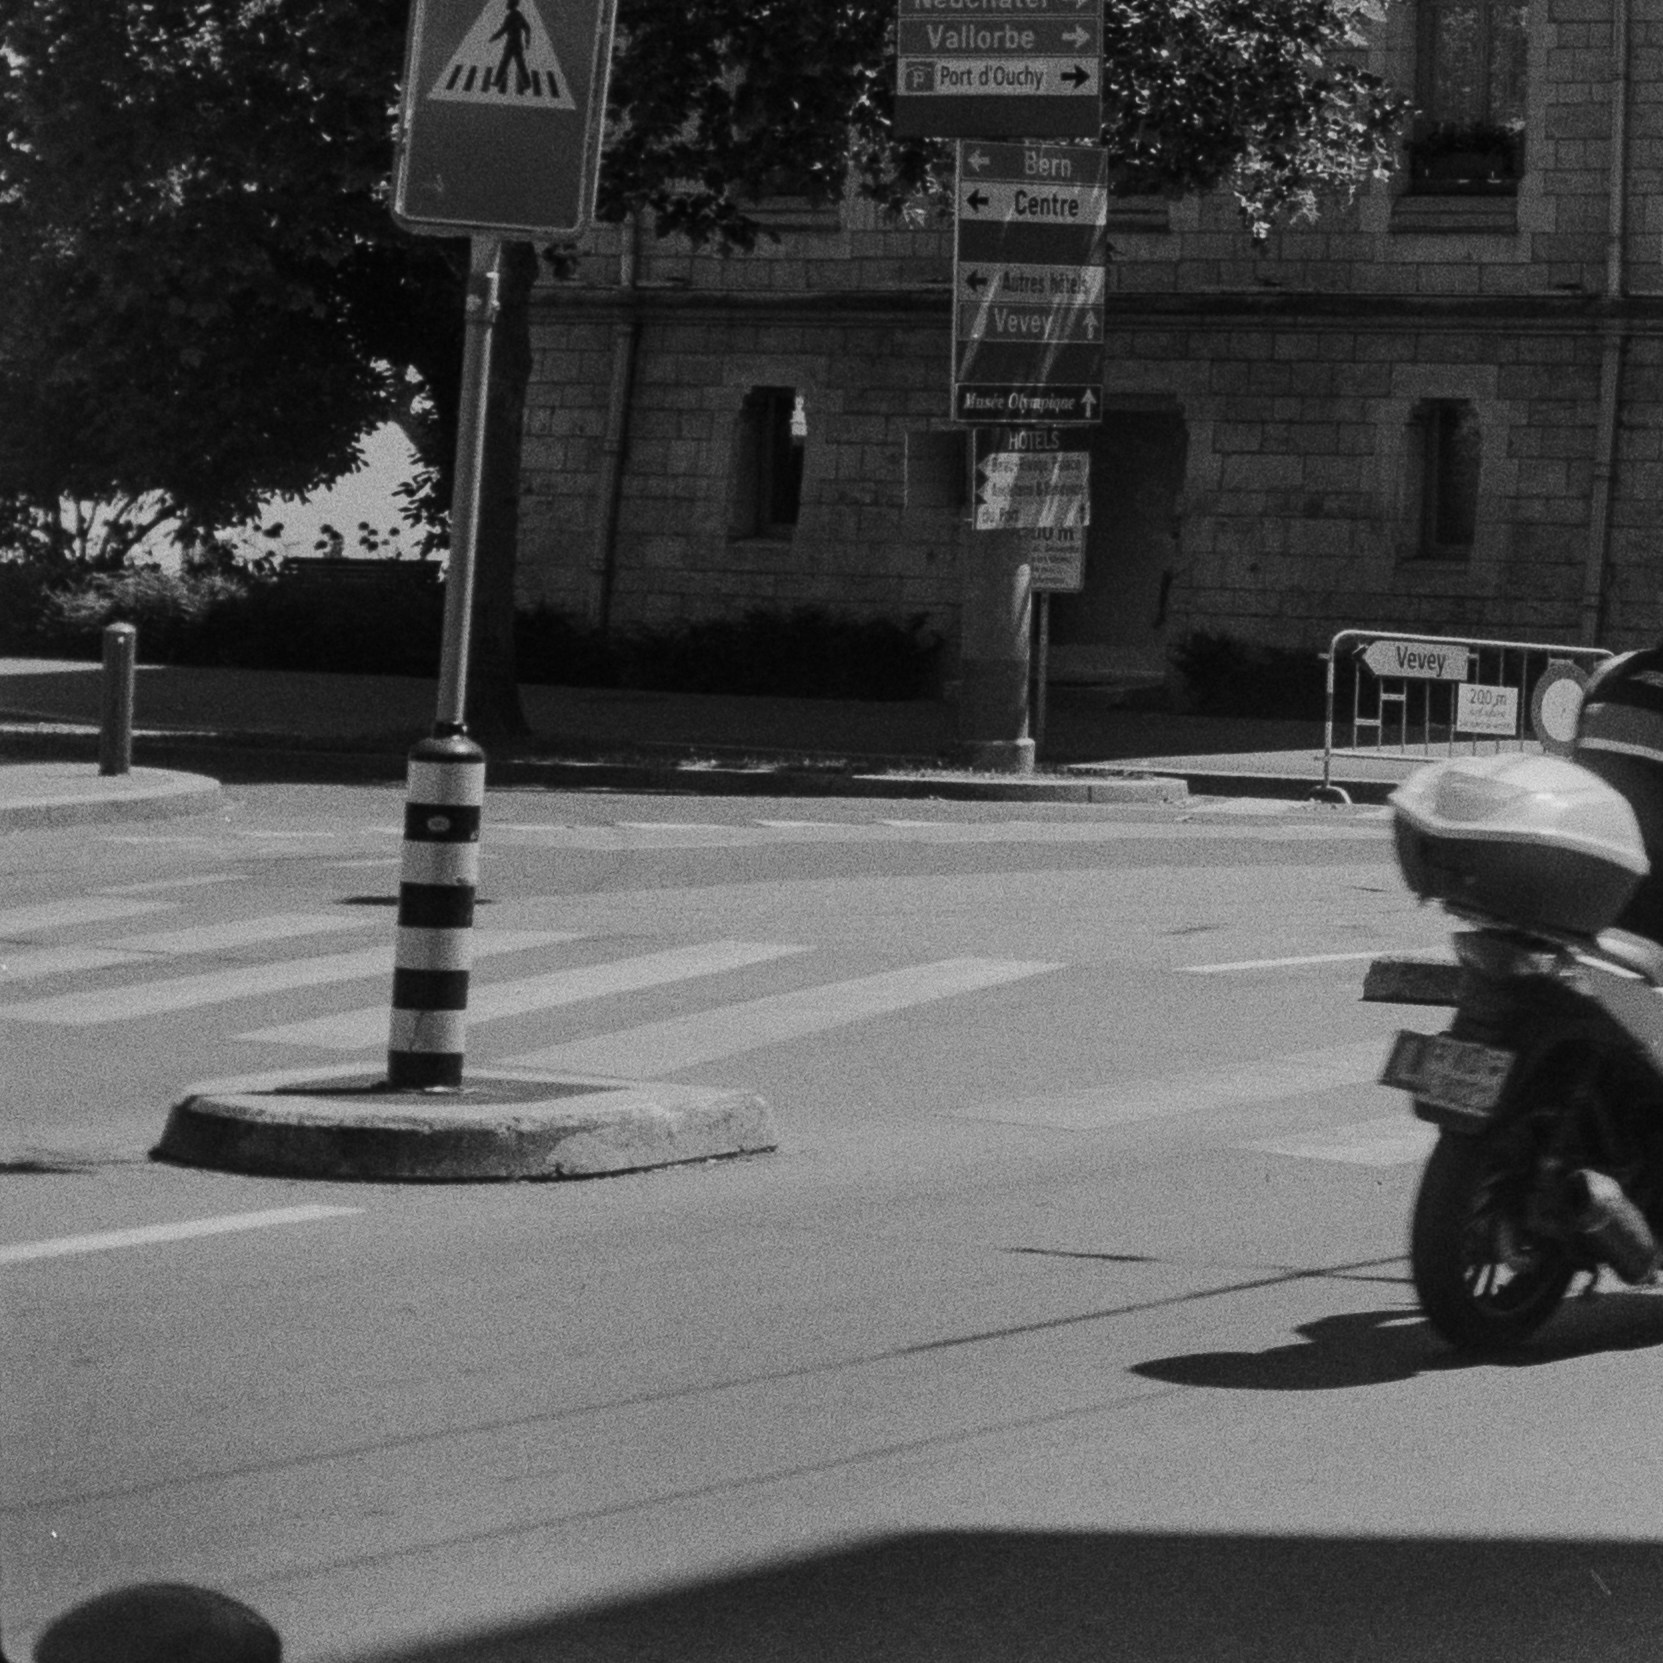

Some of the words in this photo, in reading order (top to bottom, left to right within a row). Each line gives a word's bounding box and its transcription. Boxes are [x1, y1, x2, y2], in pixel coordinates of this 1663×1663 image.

[926, 24, 1035, 49] Vallorbe
[940, 66, 973, 86] Port
[979, 65, 1044, 91] d'Ouchy
[1024, 150, 1072, 178] Bern
[1014, 189, 1079, 217] Centre
[1002, 270, 1045, 293] Autres
[993, 307, 1052, 339] Vevey
[963, 392, 1004, 409] Musée
[1007, 392, 1075, 414] Olympique
[1396, 645, 1446, 677] Vevey
